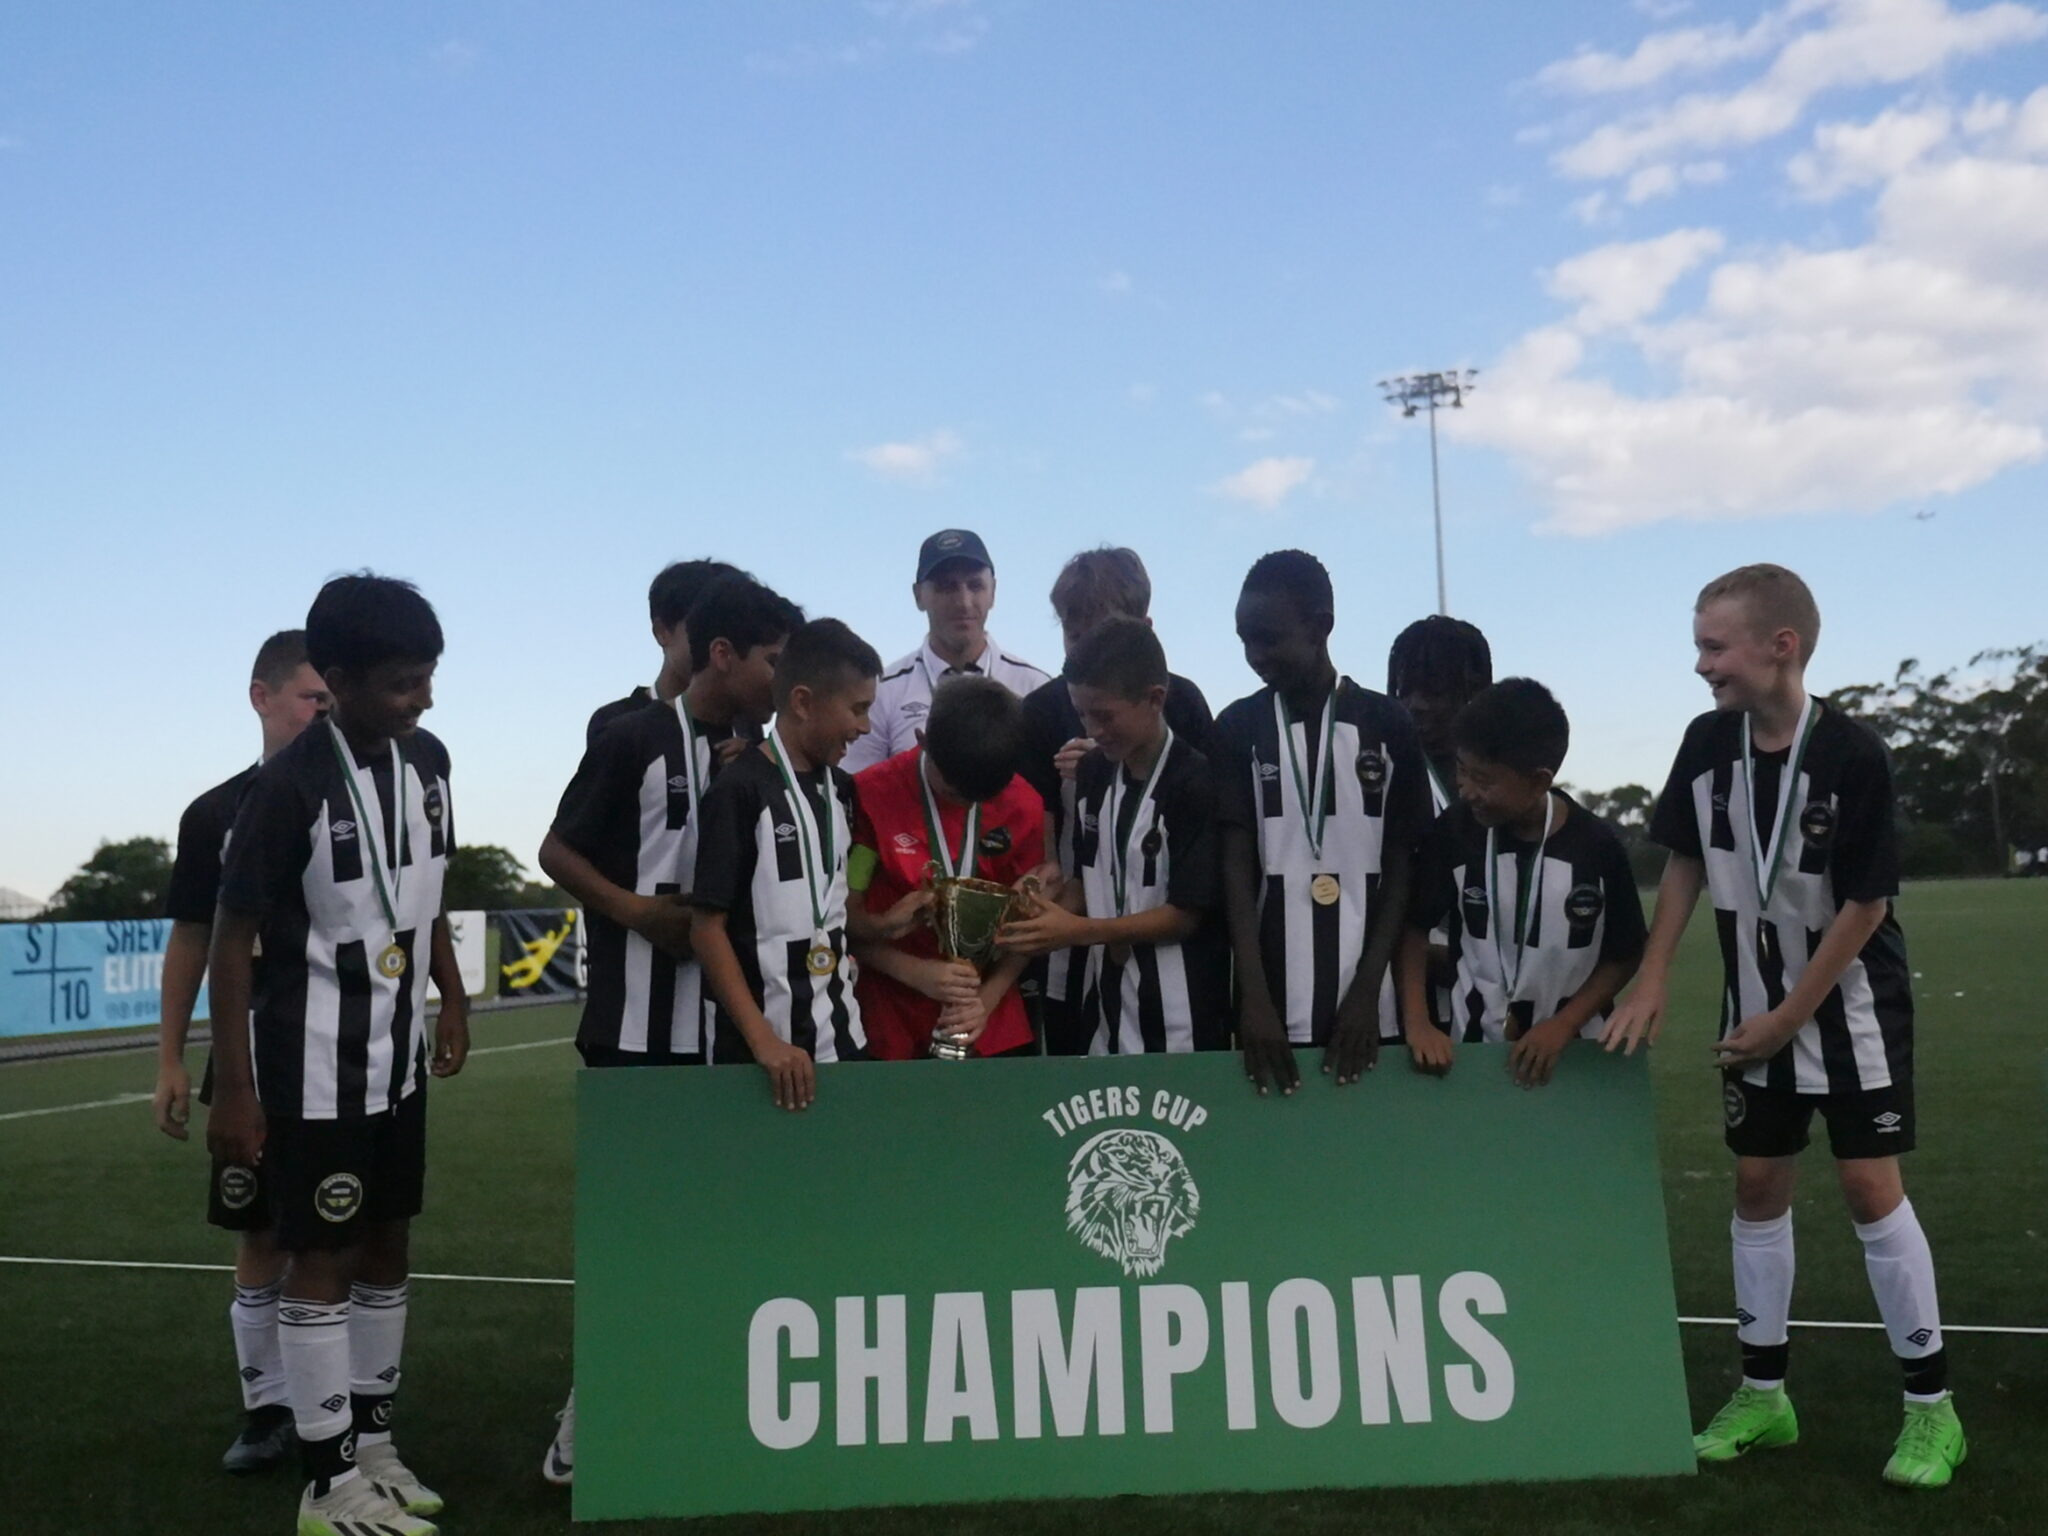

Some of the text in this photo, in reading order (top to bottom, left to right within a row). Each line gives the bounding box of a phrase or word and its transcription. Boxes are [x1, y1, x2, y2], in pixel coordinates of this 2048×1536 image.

[25, 923, 42, 963] S
[60, 979, 90, 1020] 10
[1042, 1086, 1208, 1137] TIGERS CUP
[747, 1270, 1516, 1450] CHAMPIONS
